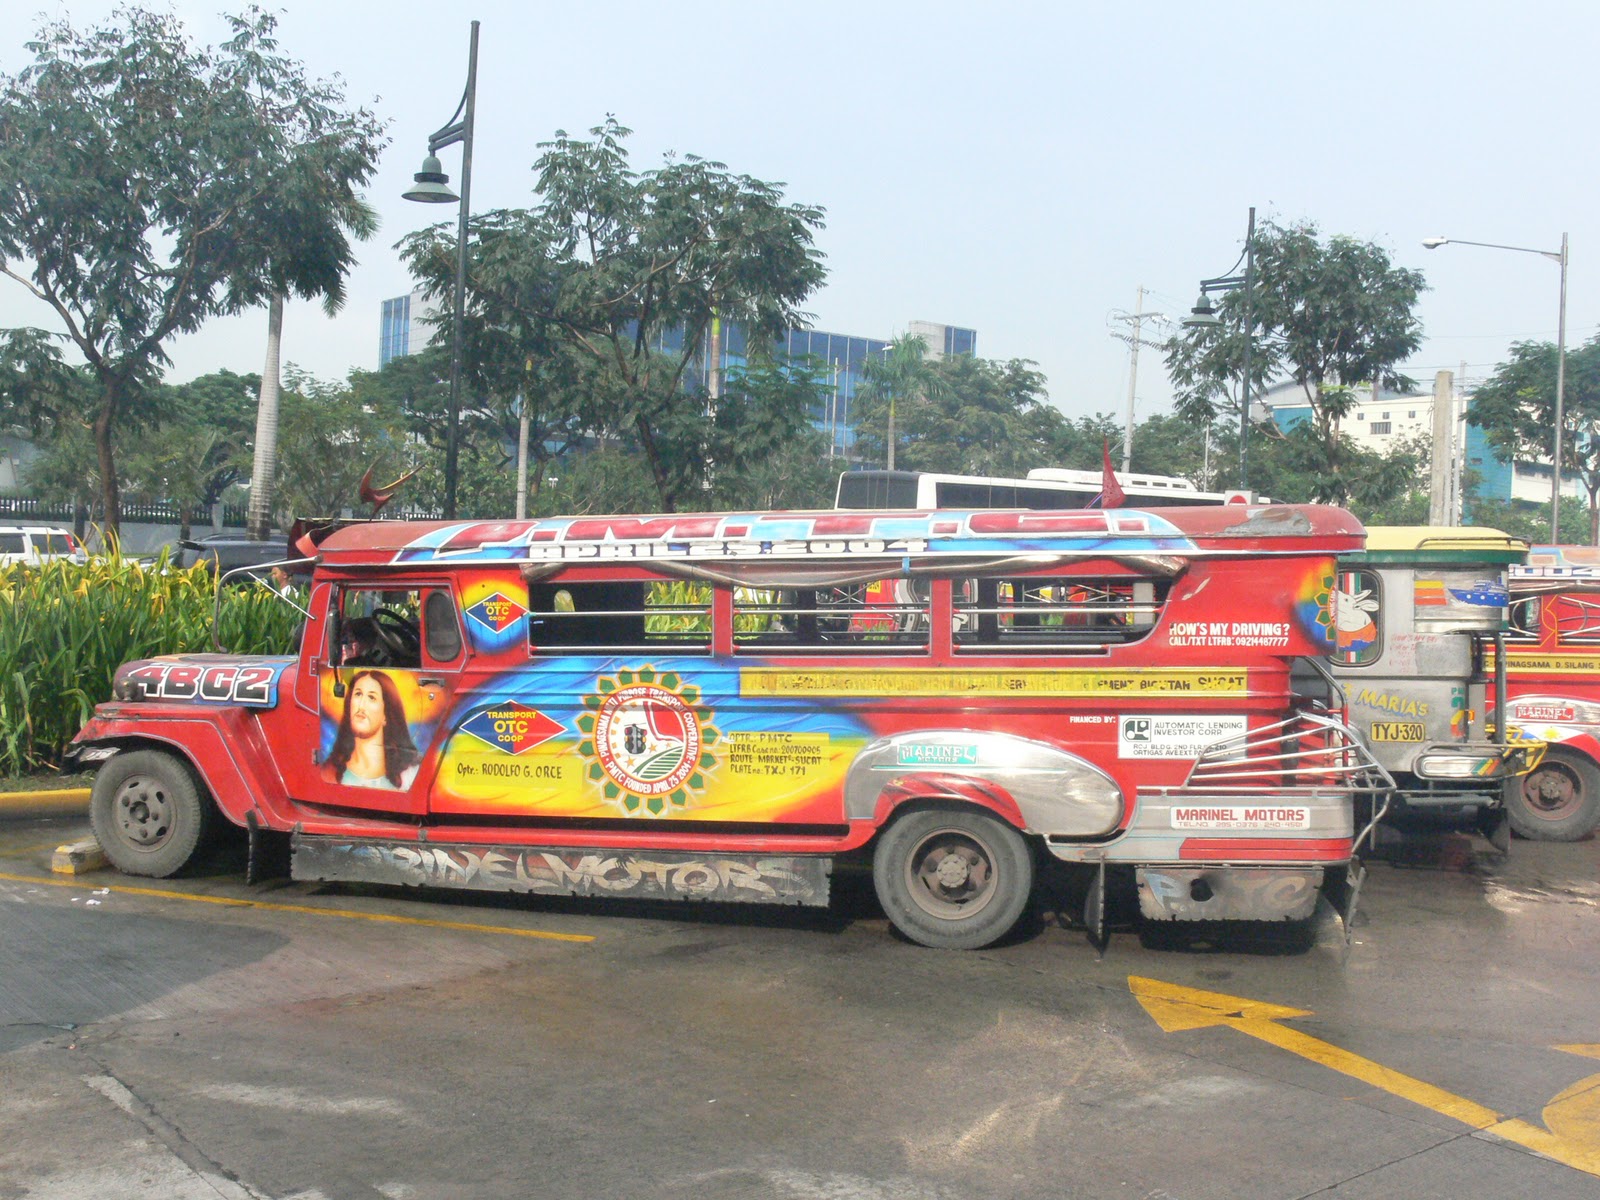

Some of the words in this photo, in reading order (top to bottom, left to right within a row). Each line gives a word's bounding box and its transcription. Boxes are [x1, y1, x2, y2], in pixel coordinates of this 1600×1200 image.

[529, 543, 687, 558] APRIL
[486, 606, 509, 615] OTC
[1169, 622, 1207, 636] HOW'S
[1209, 623, 1229, 636] MY
[1169, 637, 1206, 646] CALL/TXT
[1354, 688, 1429, 718] MARIA'S
[487, 711, 537, 719] TRANSPORT
[1516, 706, 1572, 719] MARINEL
[494, 720, 528, 733] OTC
[649, 688, 688, 713] TRANSPORT
[684, 712, 698, 761] COOPERATIVE
[1069, 716, 1102, 724] FINANCED
[1104, 716, 1116, 724] BY:
[1374, 723, 1423, 740] TYJ-320
[730, 744, 751, 754] LTFRB
[901, 745, 976, 761] MARINEL
[730, 754, 753, 763] ROUTE
[482, 763, 521, 777] RODOLFO
[524, 766, 534, 778] G.
[536, 766, 562, 779] ORCE
[730, 764, 751, 774] PLATE
[764, 766, 786, 775] TXJ
[605, 761, 625, 783] PMTC
[623, 778, 652, 794] FOUNDED
[652, 781, 671, 794] APRIL
[670, 776, 680, 788] 25
[677, 764, 692, 780] 2004
[1176, 808, 1238, 821] MARINEL
[1245, 808, 1305, 821] MOTORS
